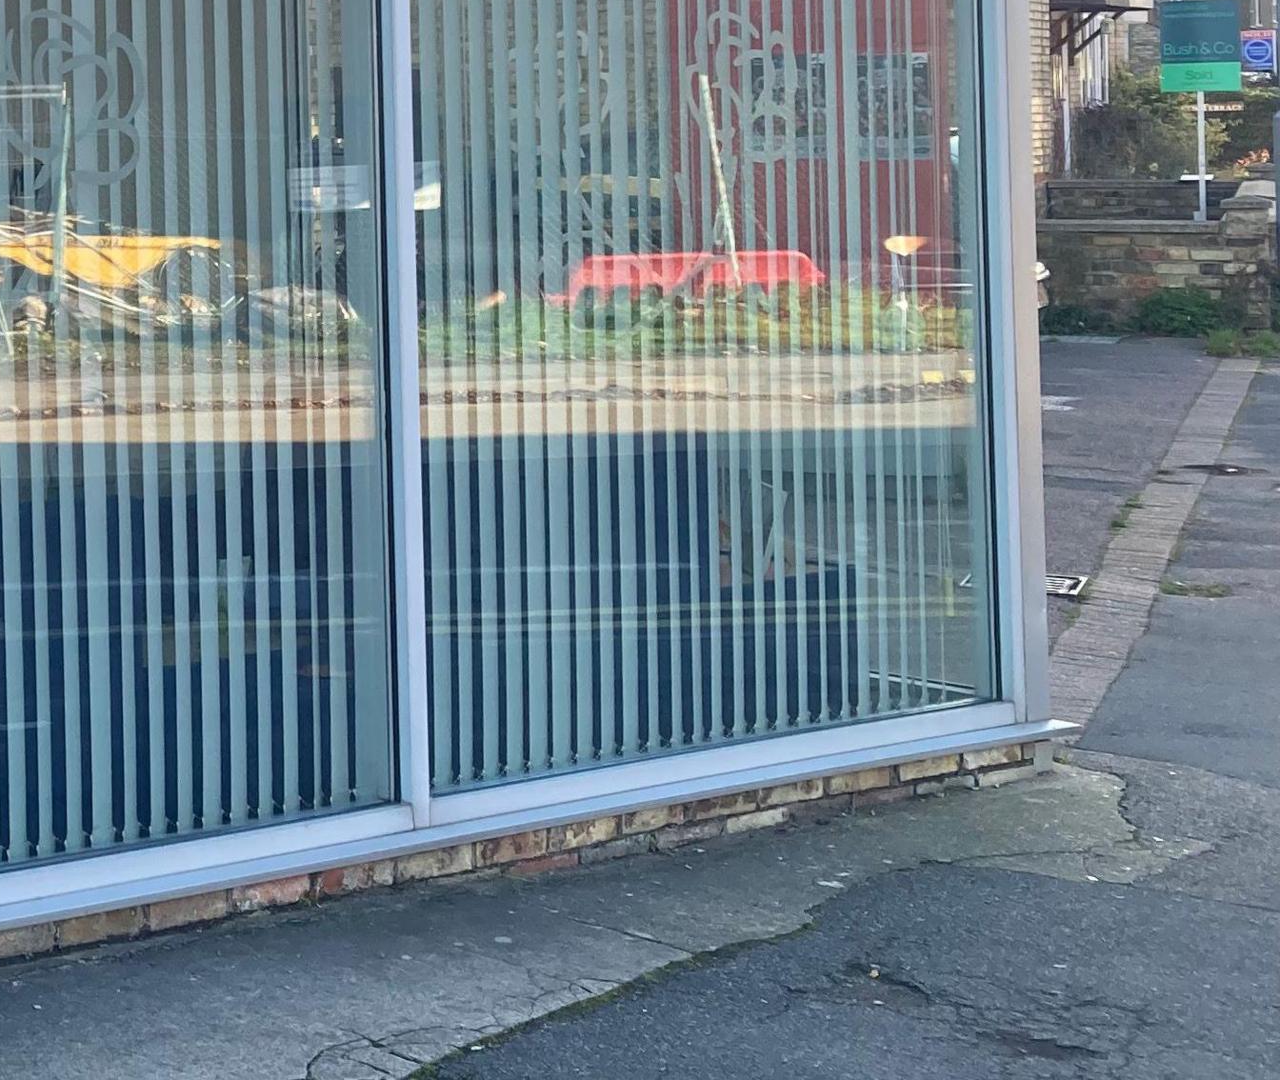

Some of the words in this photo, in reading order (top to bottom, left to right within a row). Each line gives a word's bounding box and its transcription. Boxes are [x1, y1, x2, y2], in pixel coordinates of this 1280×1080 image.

[1163, 42, 1198, 56] Bush
[1200, 41, 1211, 55] &
[1213, 41, 1235, 55] Co
